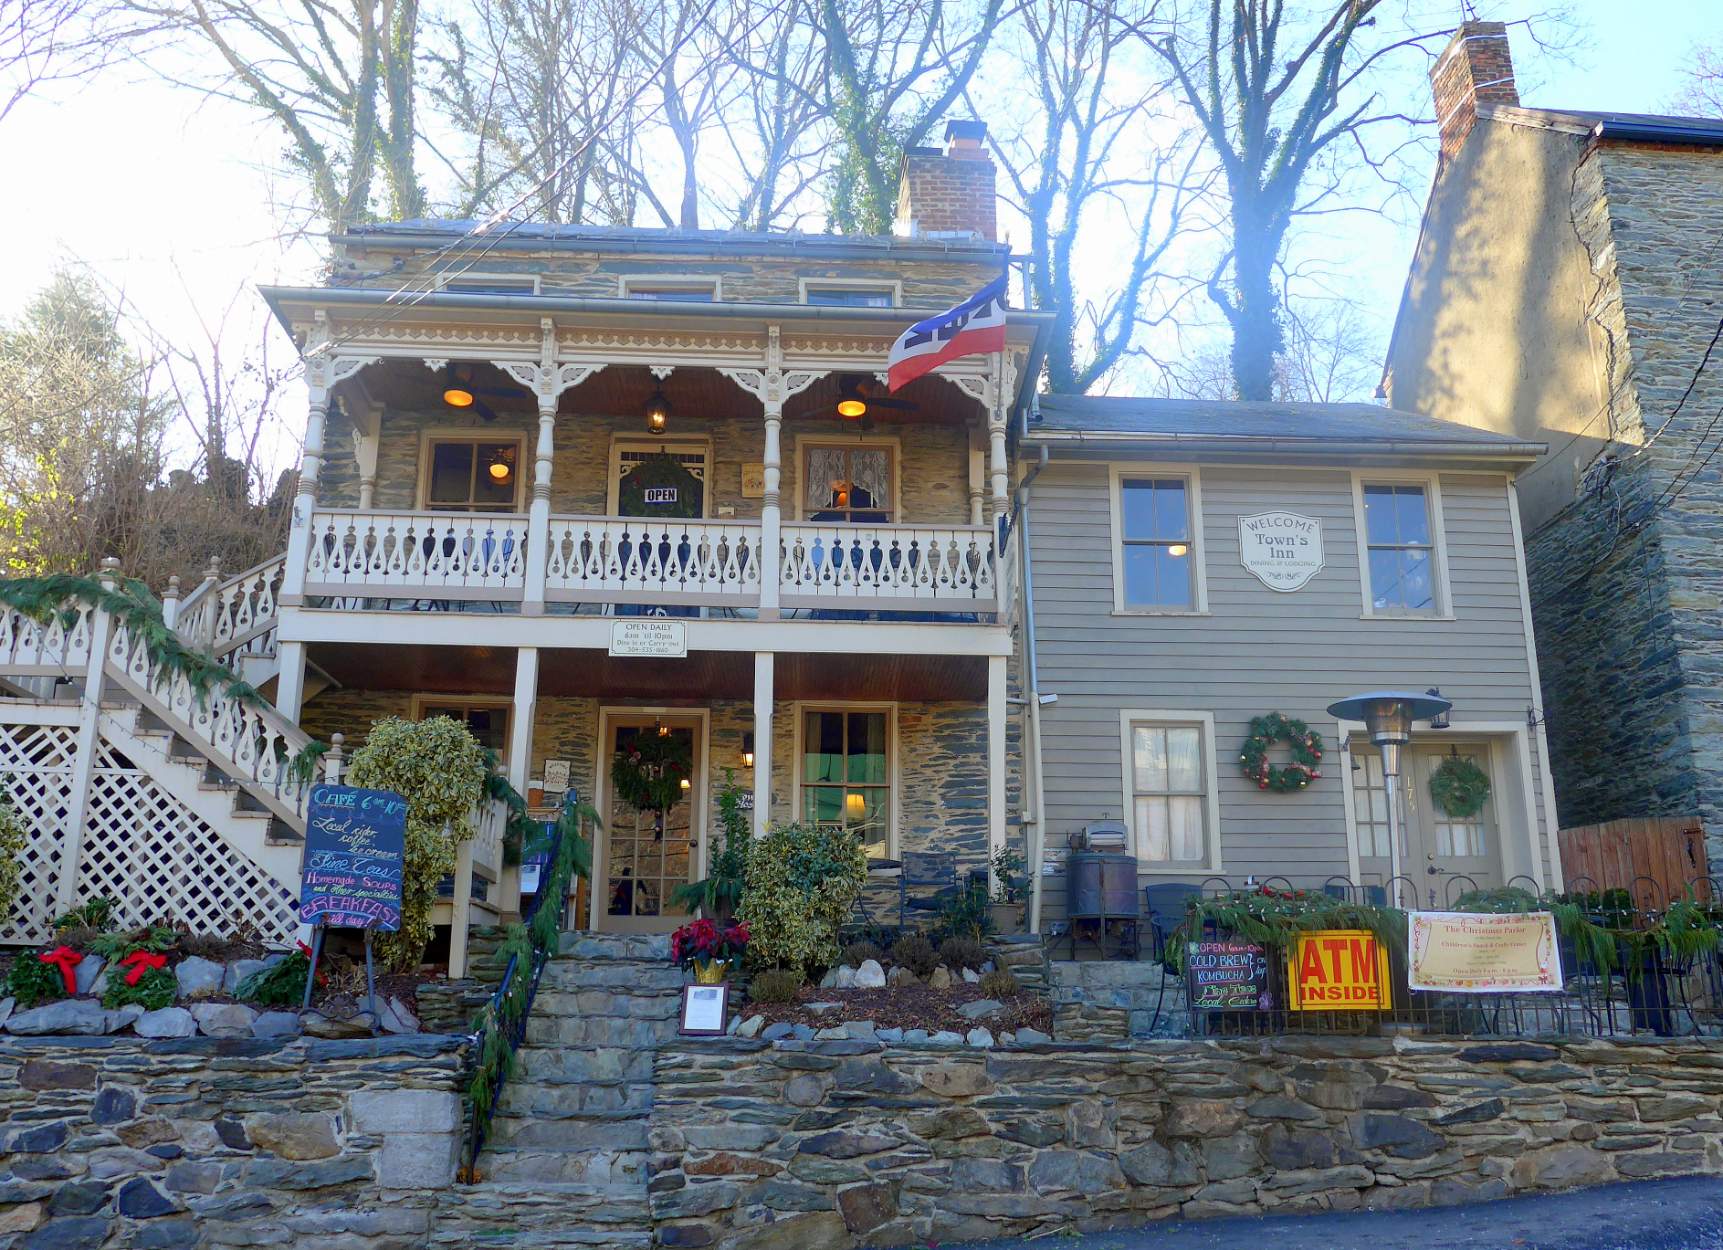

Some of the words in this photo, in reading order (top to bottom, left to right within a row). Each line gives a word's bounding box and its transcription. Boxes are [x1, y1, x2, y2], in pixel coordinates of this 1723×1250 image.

[647, 489, 676, 502] OPEN
[1246, 517, 1315, 534] WELCOME
[1255, 533, 1309, 546] Town's
[1270, 547, 1295, 559] Inn
[654, 632, 673, 641] 10pm
[311, 816, 352, 835] Local
[365, 848, 398, 858] cream
[352, 857, 401, 877] Teas
[313, 885, 327, 893] and
[301, 895, 400, 924] BREAKFAST
[1446, 925, 1459, 934] The
[1463, 926, 1503, 935] Christmas
[1199, 942, 1226, 953] OPEN
[1190, 954, 1217, 967] COLD
[1219, 954, 1248, 966] BREW
[1300, 939, 1377, 984] ATM
[1197, 970, 1245, 983] KOMBUCHA
[1300, 985, 1382, 1001] INSIDE
